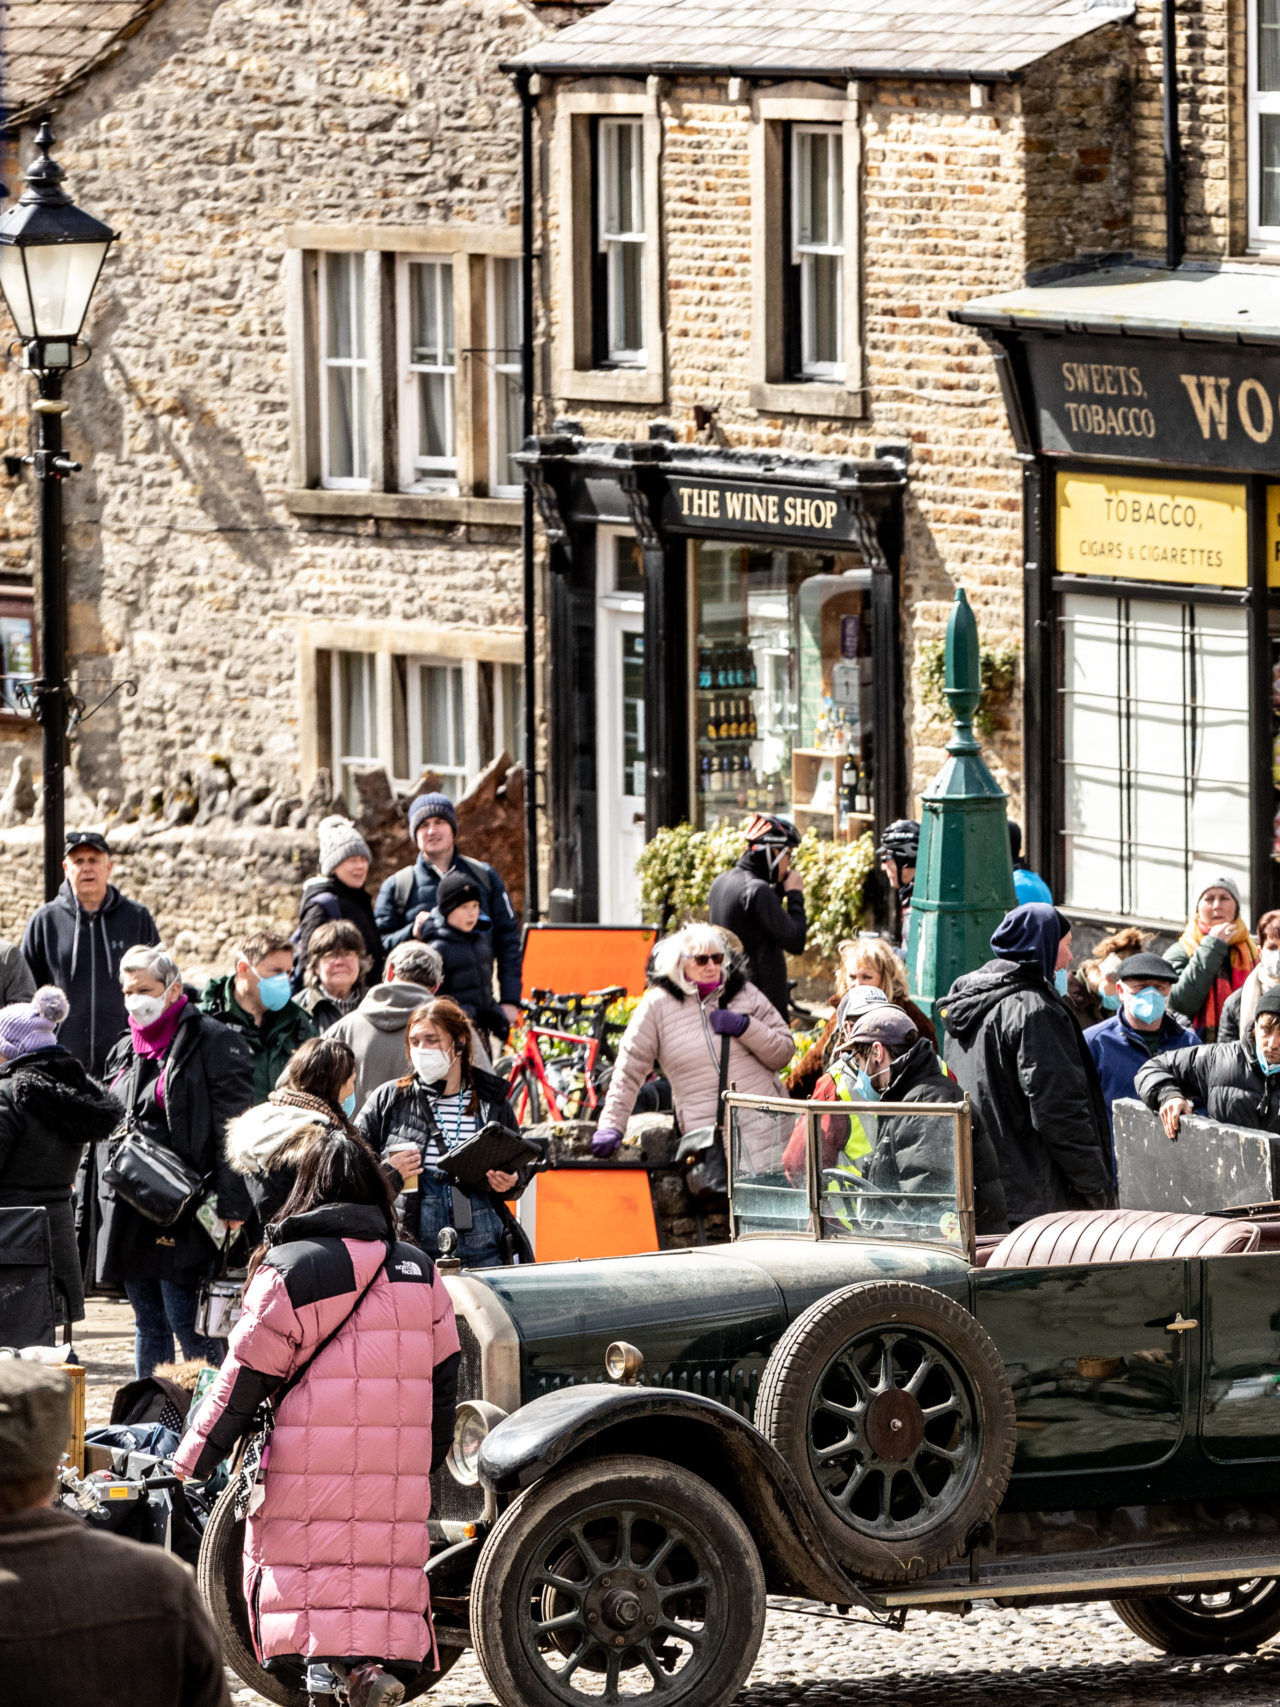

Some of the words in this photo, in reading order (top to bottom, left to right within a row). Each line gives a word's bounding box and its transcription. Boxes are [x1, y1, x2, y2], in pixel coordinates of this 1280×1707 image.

[1062, 362, 1148, 397] SWEETS,
[1066, 402, 1155, 438] TOBACCO
[679, 487, 720, 518] THE
[725, 491, 779, 524] WINE
[784, 496, 837, 529] SHOP
[1105, 499, 1202, 529] TOBACCO,
[1080, 540, 1123, 559] CIGARS
[1141, 544, 1223, 567] CIGARETTES
